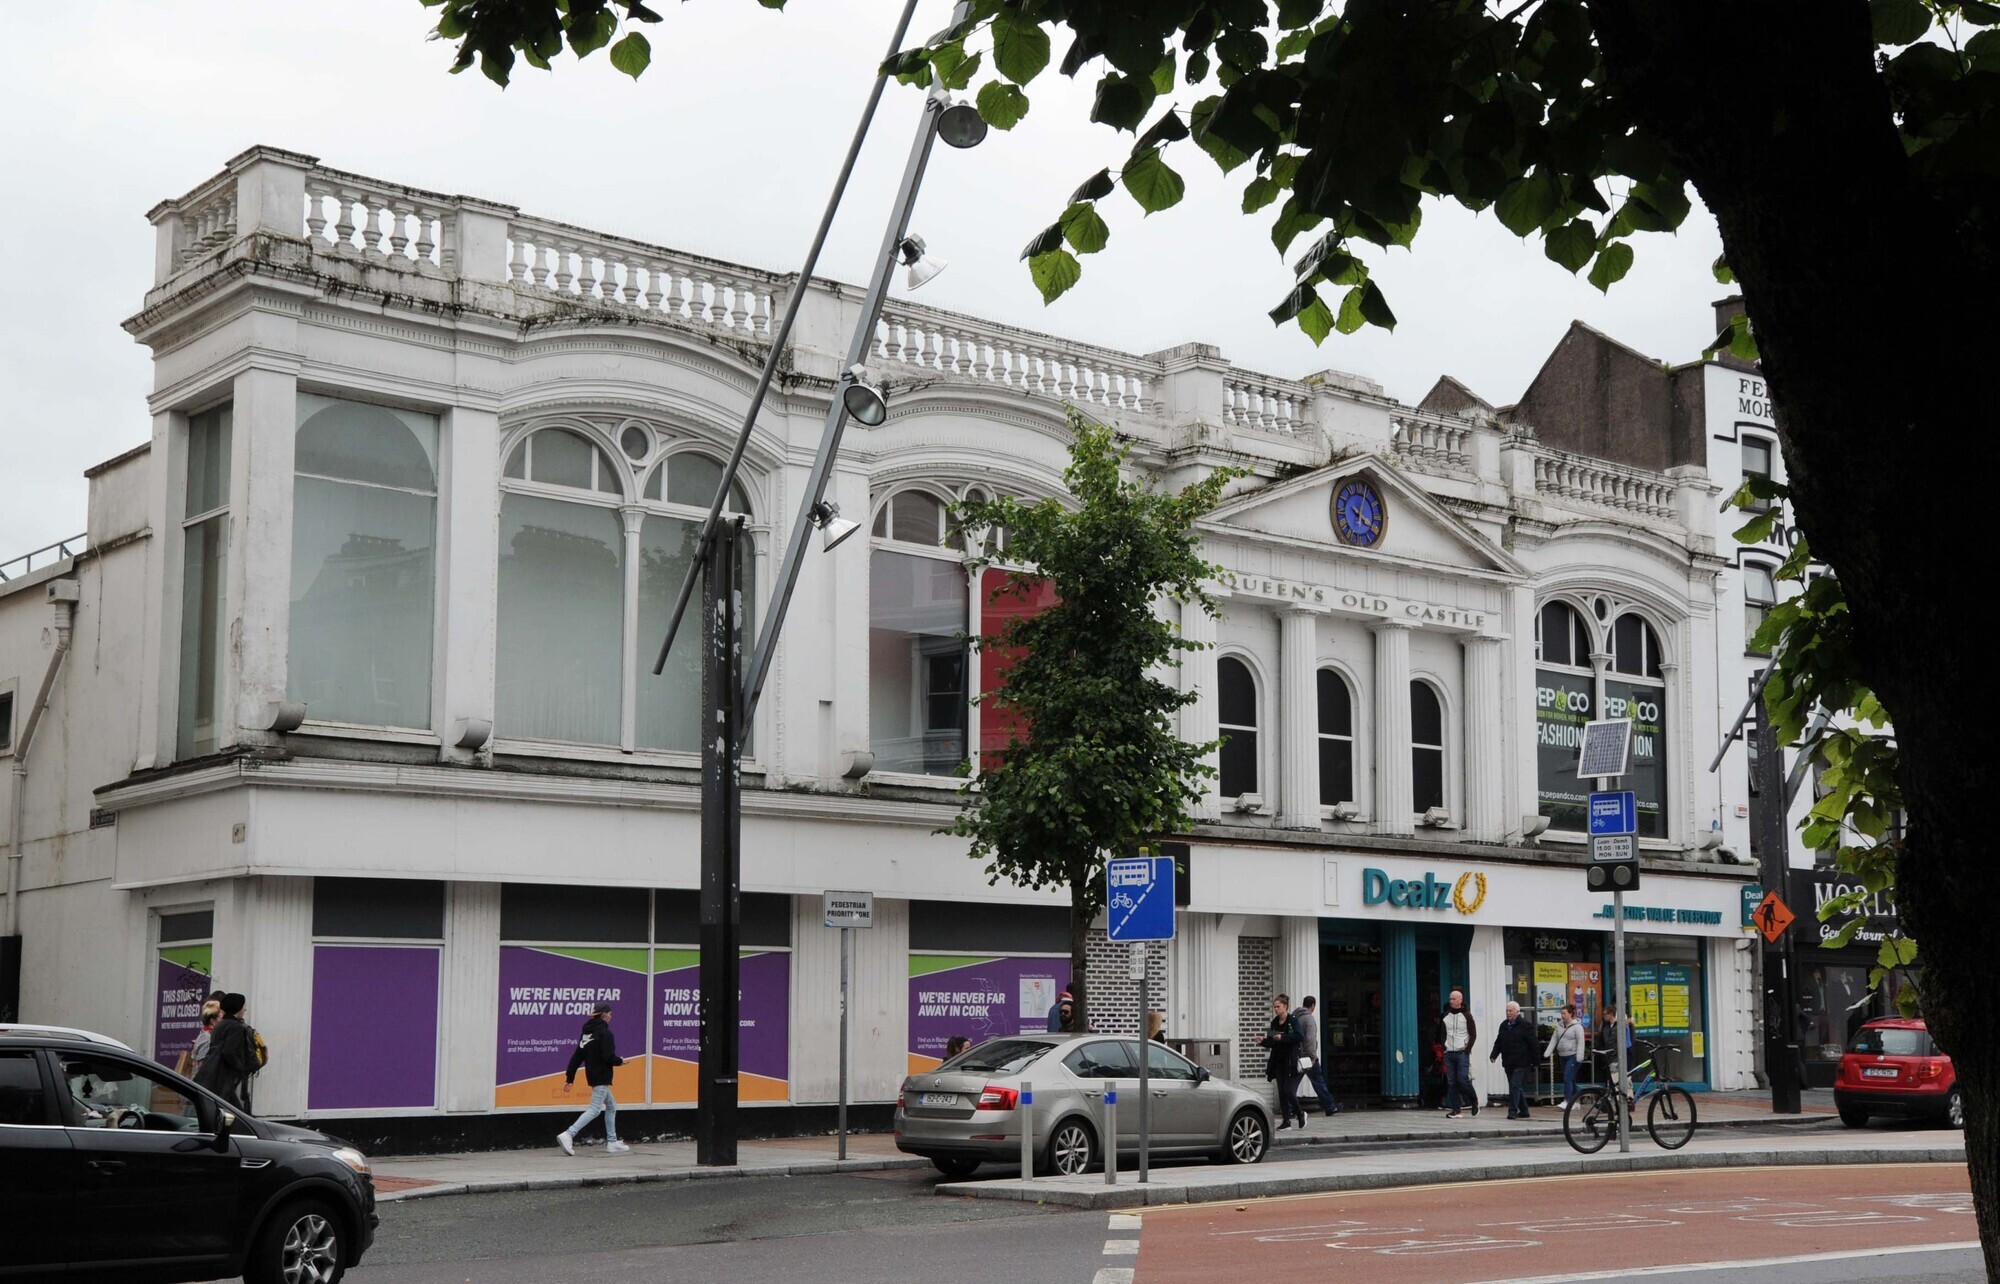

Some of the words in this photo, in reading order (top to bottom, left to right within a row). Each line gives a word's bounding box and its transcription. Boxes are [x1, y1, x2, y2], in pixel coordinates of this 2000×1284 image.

[1225, 577, 1324, 602] QUEEN'S
[1342, 593, 1389, 613] OLD
[1406, 604, 1485, 628] CASTLE
[1363, 868, 1453, 909] Dealz
[831, 901, 866, 909] PEDESTRIAN
[827, 910, 853, 918] PRIORITY
[1647, 907, 1675, 923] VALUE
[1677, 909, 1722, 925] EVERYDAY
[510, 987, 552, 1000] WE'RE
[553, 987, 595, 1000] NEVER
[597, 988, 621, 1001] FAR
[664, 989, 690, 1001] THIS
[918, 991, 951, 1003] WE'RE
[952, 992, 986, 1004] NEVER
[987, 992, 1006, 1004] FAR
[162, 1005, 177, 1018] NOW
[177, 1004, 200, 1017] CLOSED
[509, 1002, 547, 1015] AWAY
[549, 1002, 564, 1015] IN
[664, 1003, 693, 1015] NOW
[918, 1004, 946, 1016] AWAY
[950, 1005, 961, 1017] IN
[962, 1005, 989, 1017] CORK
[531, 1039, 553, 1047] Blackpool
